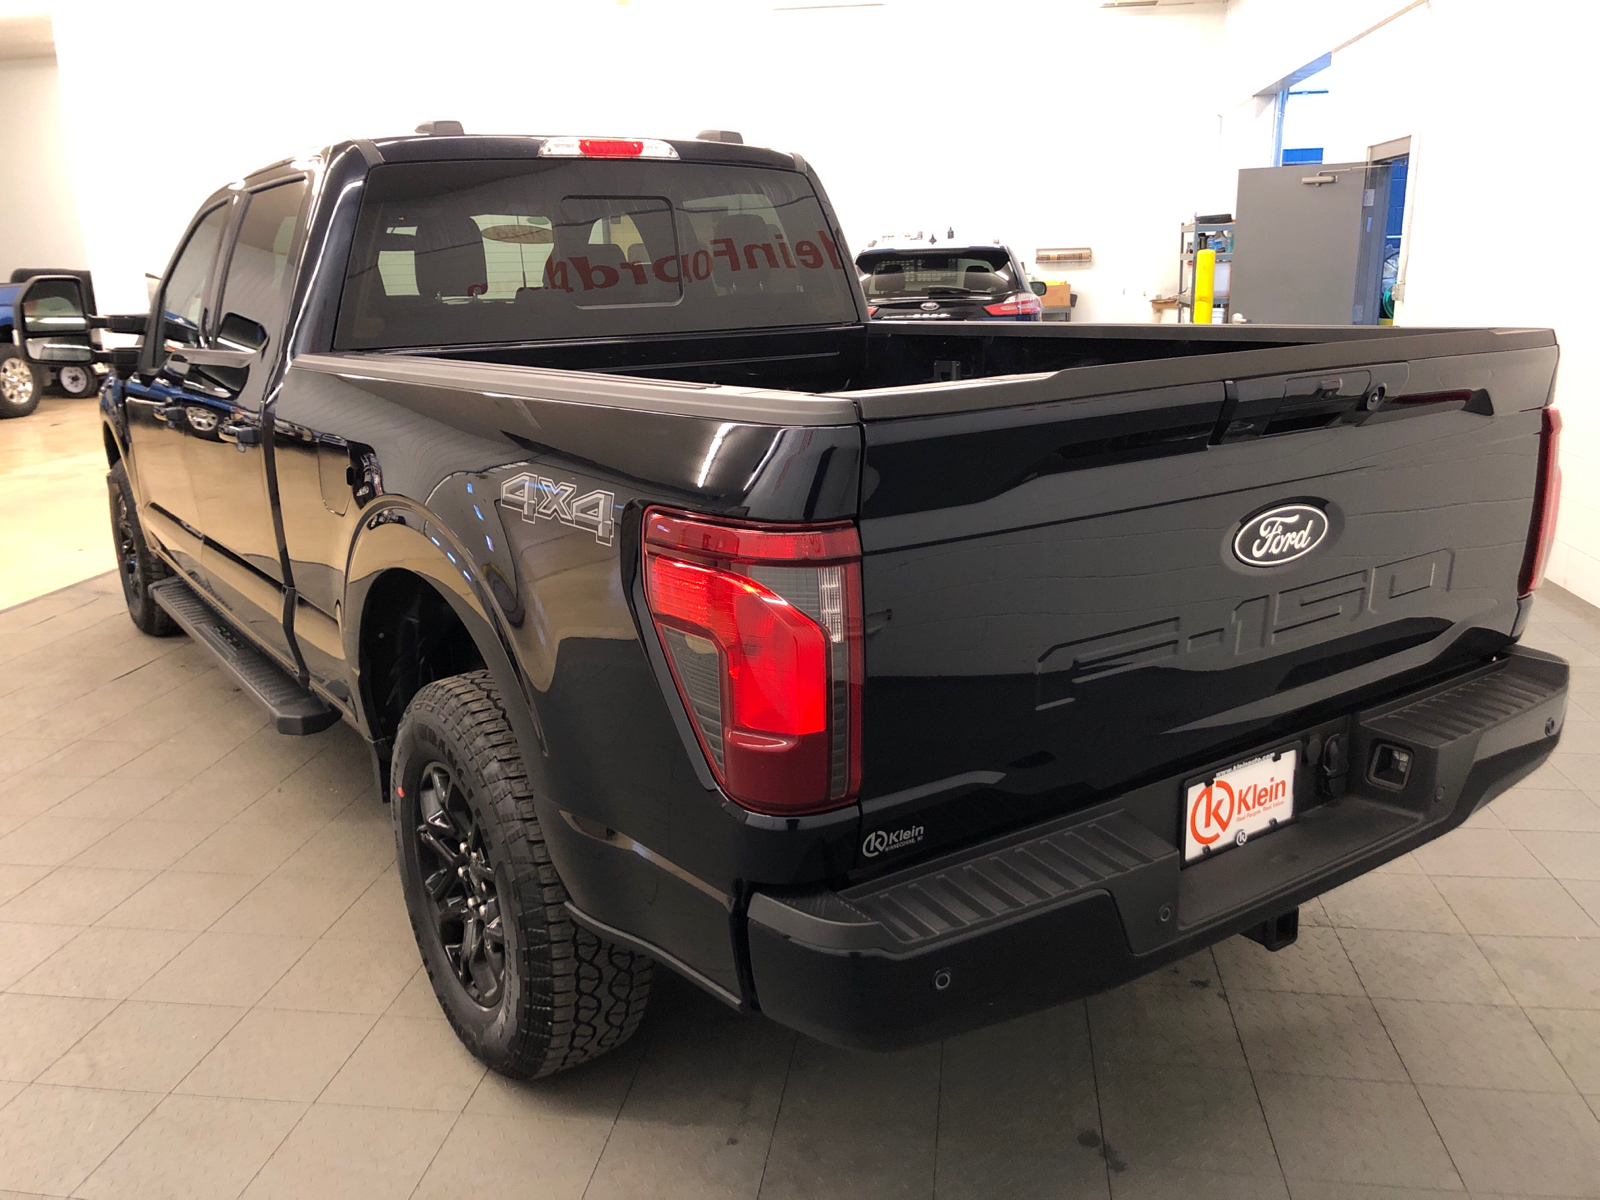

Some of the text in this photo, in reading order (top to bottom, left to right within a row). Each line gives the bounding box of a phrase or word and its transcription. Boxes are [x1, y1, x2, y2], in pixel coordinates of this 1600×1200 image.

[1251, 514, 1314, 558] Ford
[1036, 547, 1455, 711] F-150
[1236, 815, 1246, 823] Real
[1263, 803, 1272, 812] Real
[1237, 777, 1286, 815] Klein
[888, 825, 924, 845] Klein
